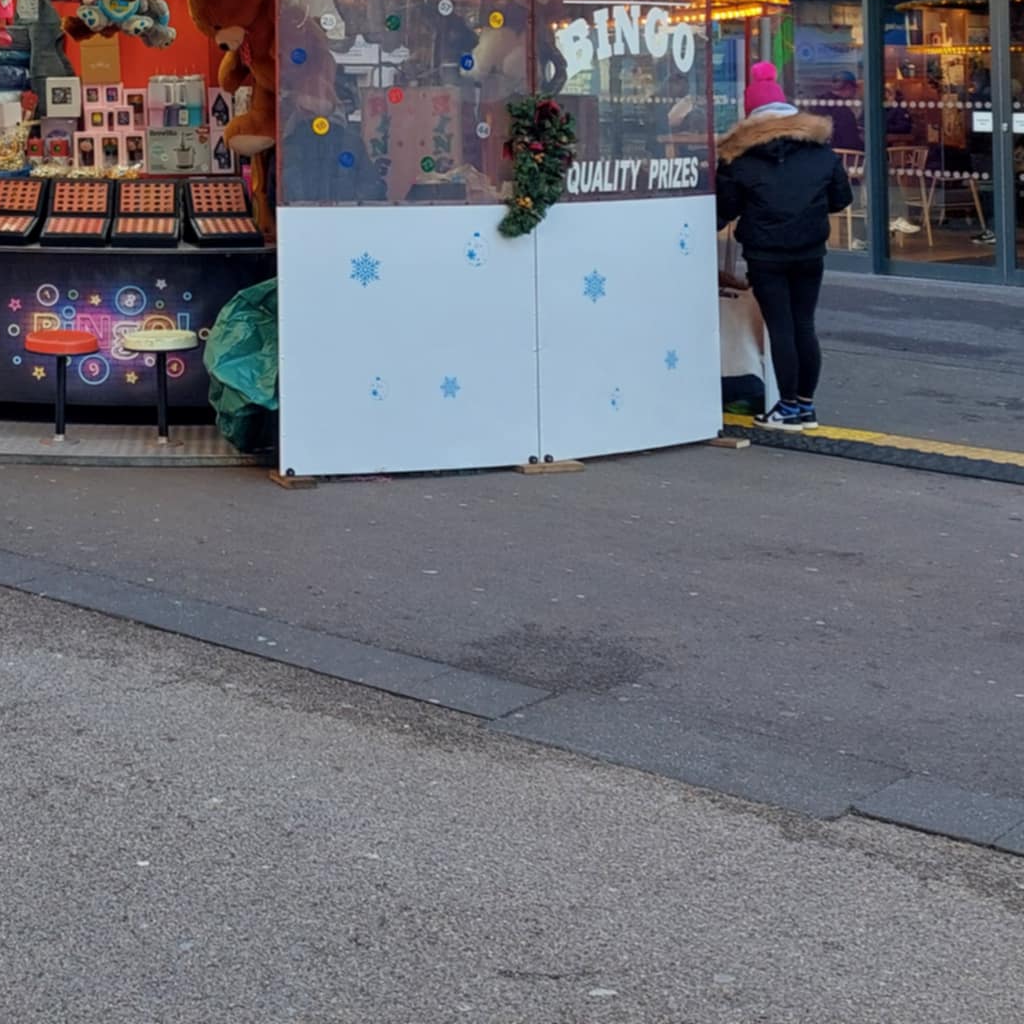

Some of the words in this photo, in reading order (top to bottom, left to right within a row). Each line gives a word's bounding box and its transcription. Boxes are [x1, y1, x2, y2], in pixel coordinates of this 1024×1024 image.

[555, 5, 695, 81] BINGO
[566, 159, 641, 195] QUALITY
[648, 157, 698, 190] PRIZES
